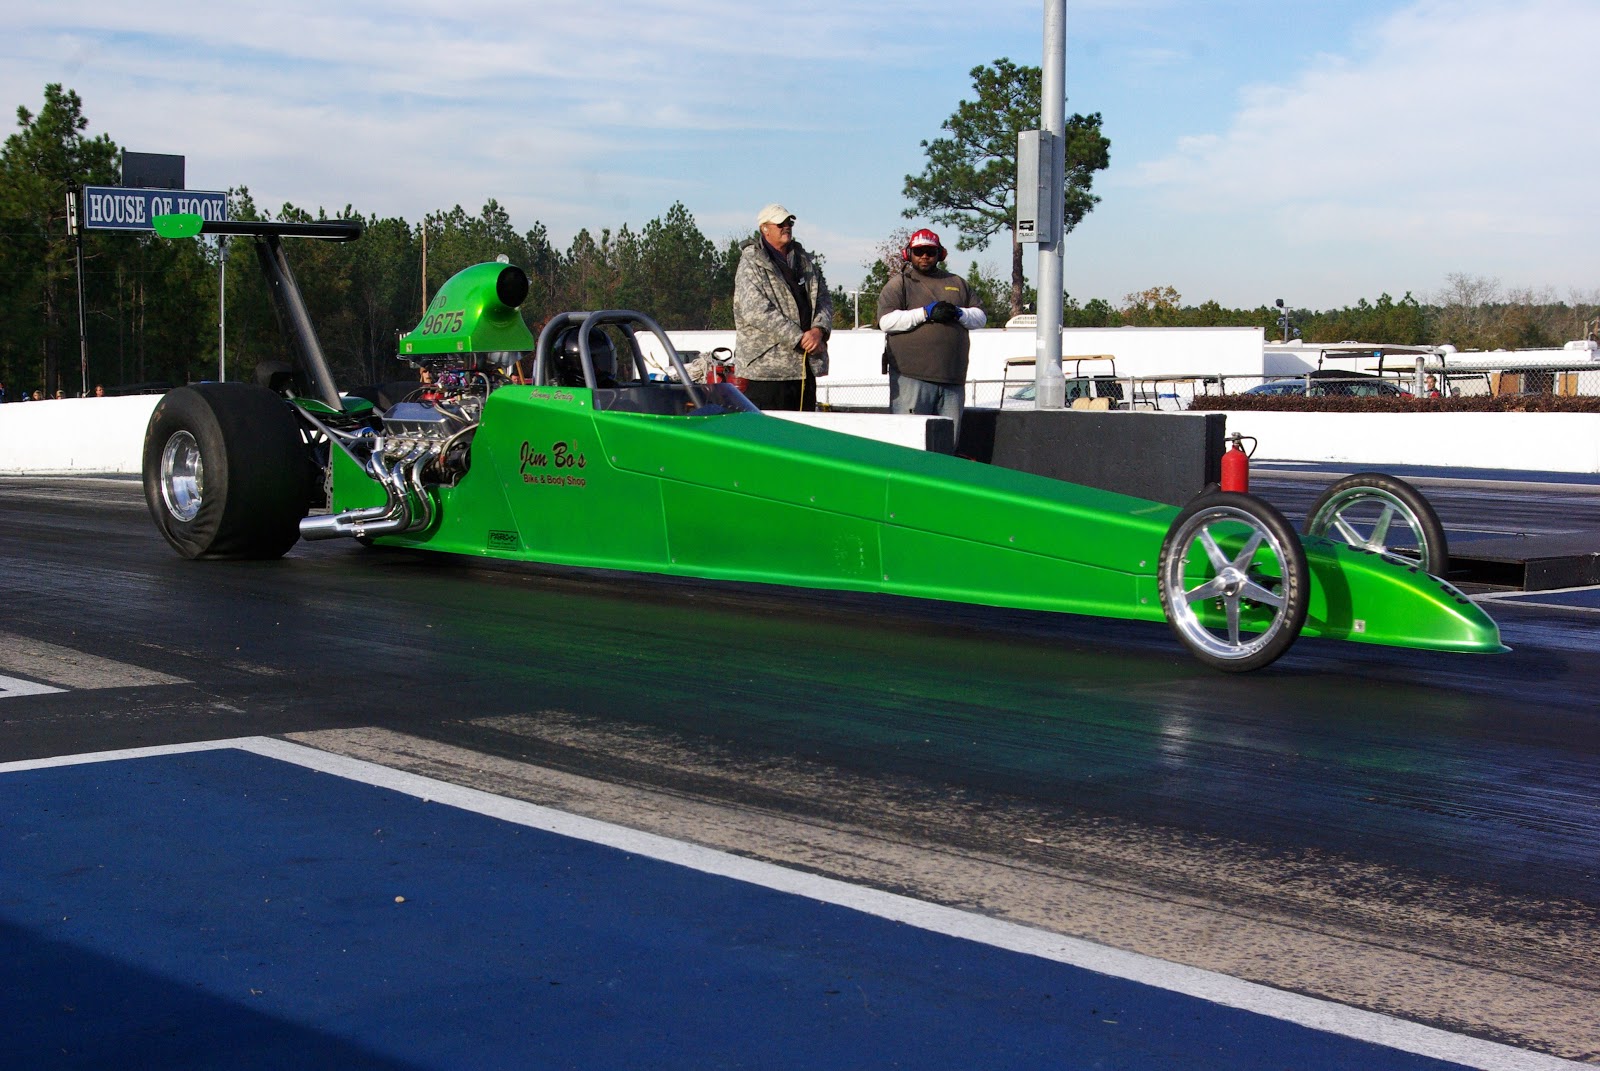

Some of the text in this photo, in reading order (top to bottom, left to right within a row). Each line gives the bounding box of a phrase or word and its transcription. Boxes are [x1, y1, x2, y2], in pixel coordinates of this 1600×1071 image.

[90, 194, 223, 224] HOUSE OF HOOK
[422, 310, 464, 336] 9675
[520, 440, 587, 474] Jim Bo's
[540, 474, 546, 484] &
[547, 475, 565, 488] Body
[566, 476, 586, 488] Shop
